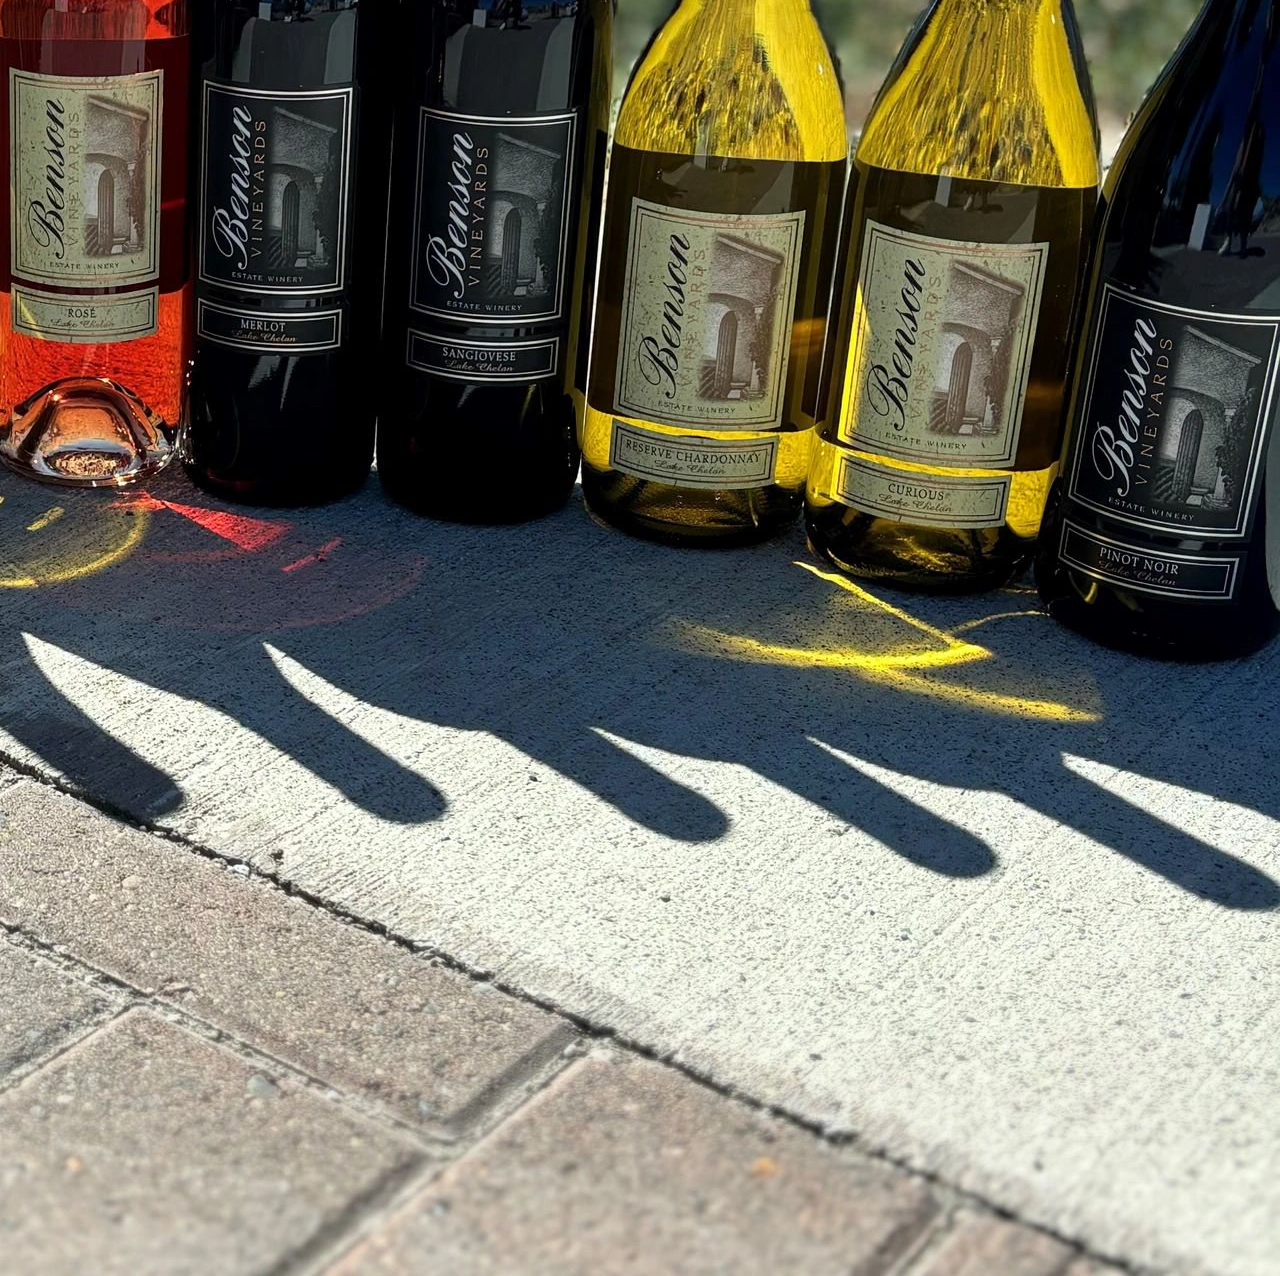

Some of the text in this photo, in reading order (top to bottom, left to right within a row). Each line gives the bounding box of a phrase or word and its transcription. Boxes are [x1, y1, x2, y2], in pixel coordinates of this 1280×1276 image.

[28, 98, 66, 260] Benson
[67, 113, 80, 246] VINEYARDS
[212, 105, 252, 270] Benson
[251, 121, 266, 258] VINEYARDS
[426, 131, 474, 299] Benson
[468, 147, 489, 286] VINEYARDS
[86, 262, 120, 270] WINERY
[231, 271, 304, 283] ESTATE WINERY
[68, 307, 97, 318] ROSÉ
[447, 300, 481, 310] ESTATE
[638, 232, 691, 400] Benson
[240, 319, 286, 332] MERLOT
[260, 332, 297, 342] Chelan
[442, 347, 516, 361] SANGIOVESE
[866, 258, 926, 431] Benson
[658, 400, 736, 414] ESTATE WINERY
[1092, 318, 1157, 497] Benson
[1135, 338, 1173, 485] VINEYARDS
[625, 440, 761, 464] RESERVE CHARDONNAY
[885, 432, 967, 449] ESTATE WINERY
[888, 483, 944, 501] CURIOUS
[1108, 496, 1195, 521] ESTATE WINERY
[1099, 547, 1179, 575] PINOT NOIR
